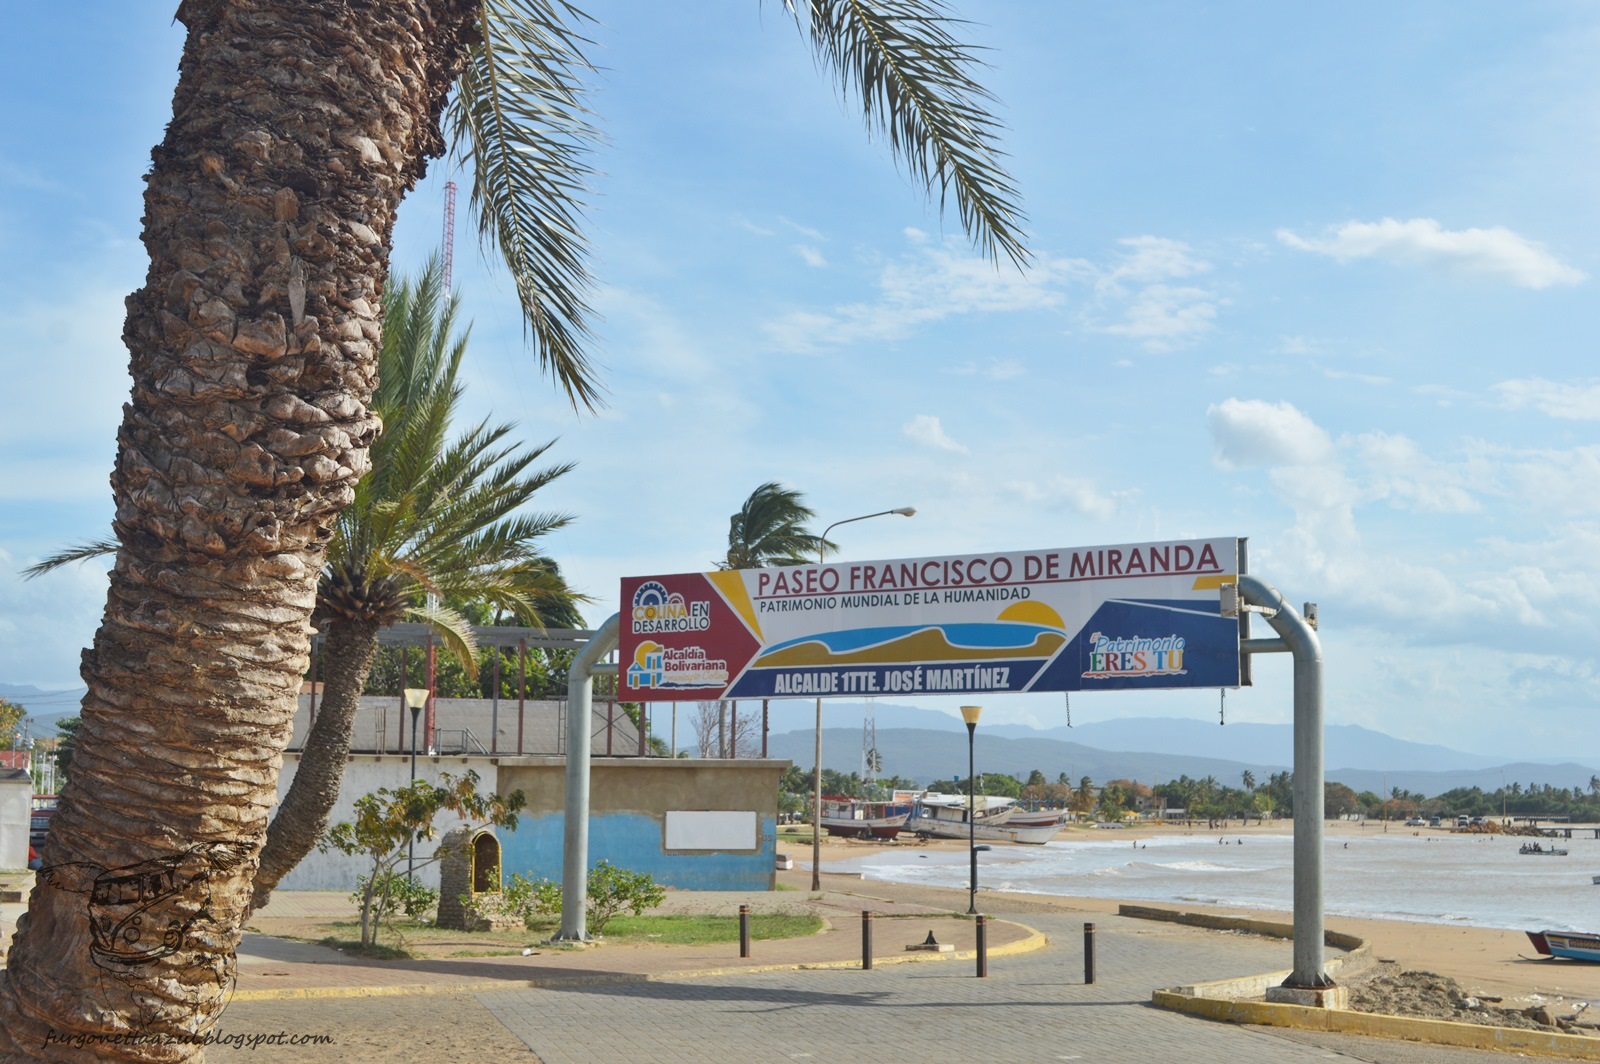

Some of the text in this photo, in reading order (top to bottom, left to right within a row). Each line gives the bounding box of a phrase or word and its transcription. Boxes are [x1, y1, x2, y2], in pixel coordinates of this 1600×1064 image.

[758, 543, 1219, 596] PASEO FRANCISCO DE MIRANDA
[760, 586, 1031, 613] PATRIMONIO MUNDIAL DE LA HUMANIDAD
[633, 602, 709, 621] COLINA EN
[633, 617, 710, 633] DESARROLLO
[1096, 635, 1185, 654] Patrimonio
[664, 660, 726, 672] Bolivariana
[1091, 651, 1147, 672] ERES
[774, 665, 1010, 694] ALCALDE 1TTE. JOSÉ MARTÍNEZ
